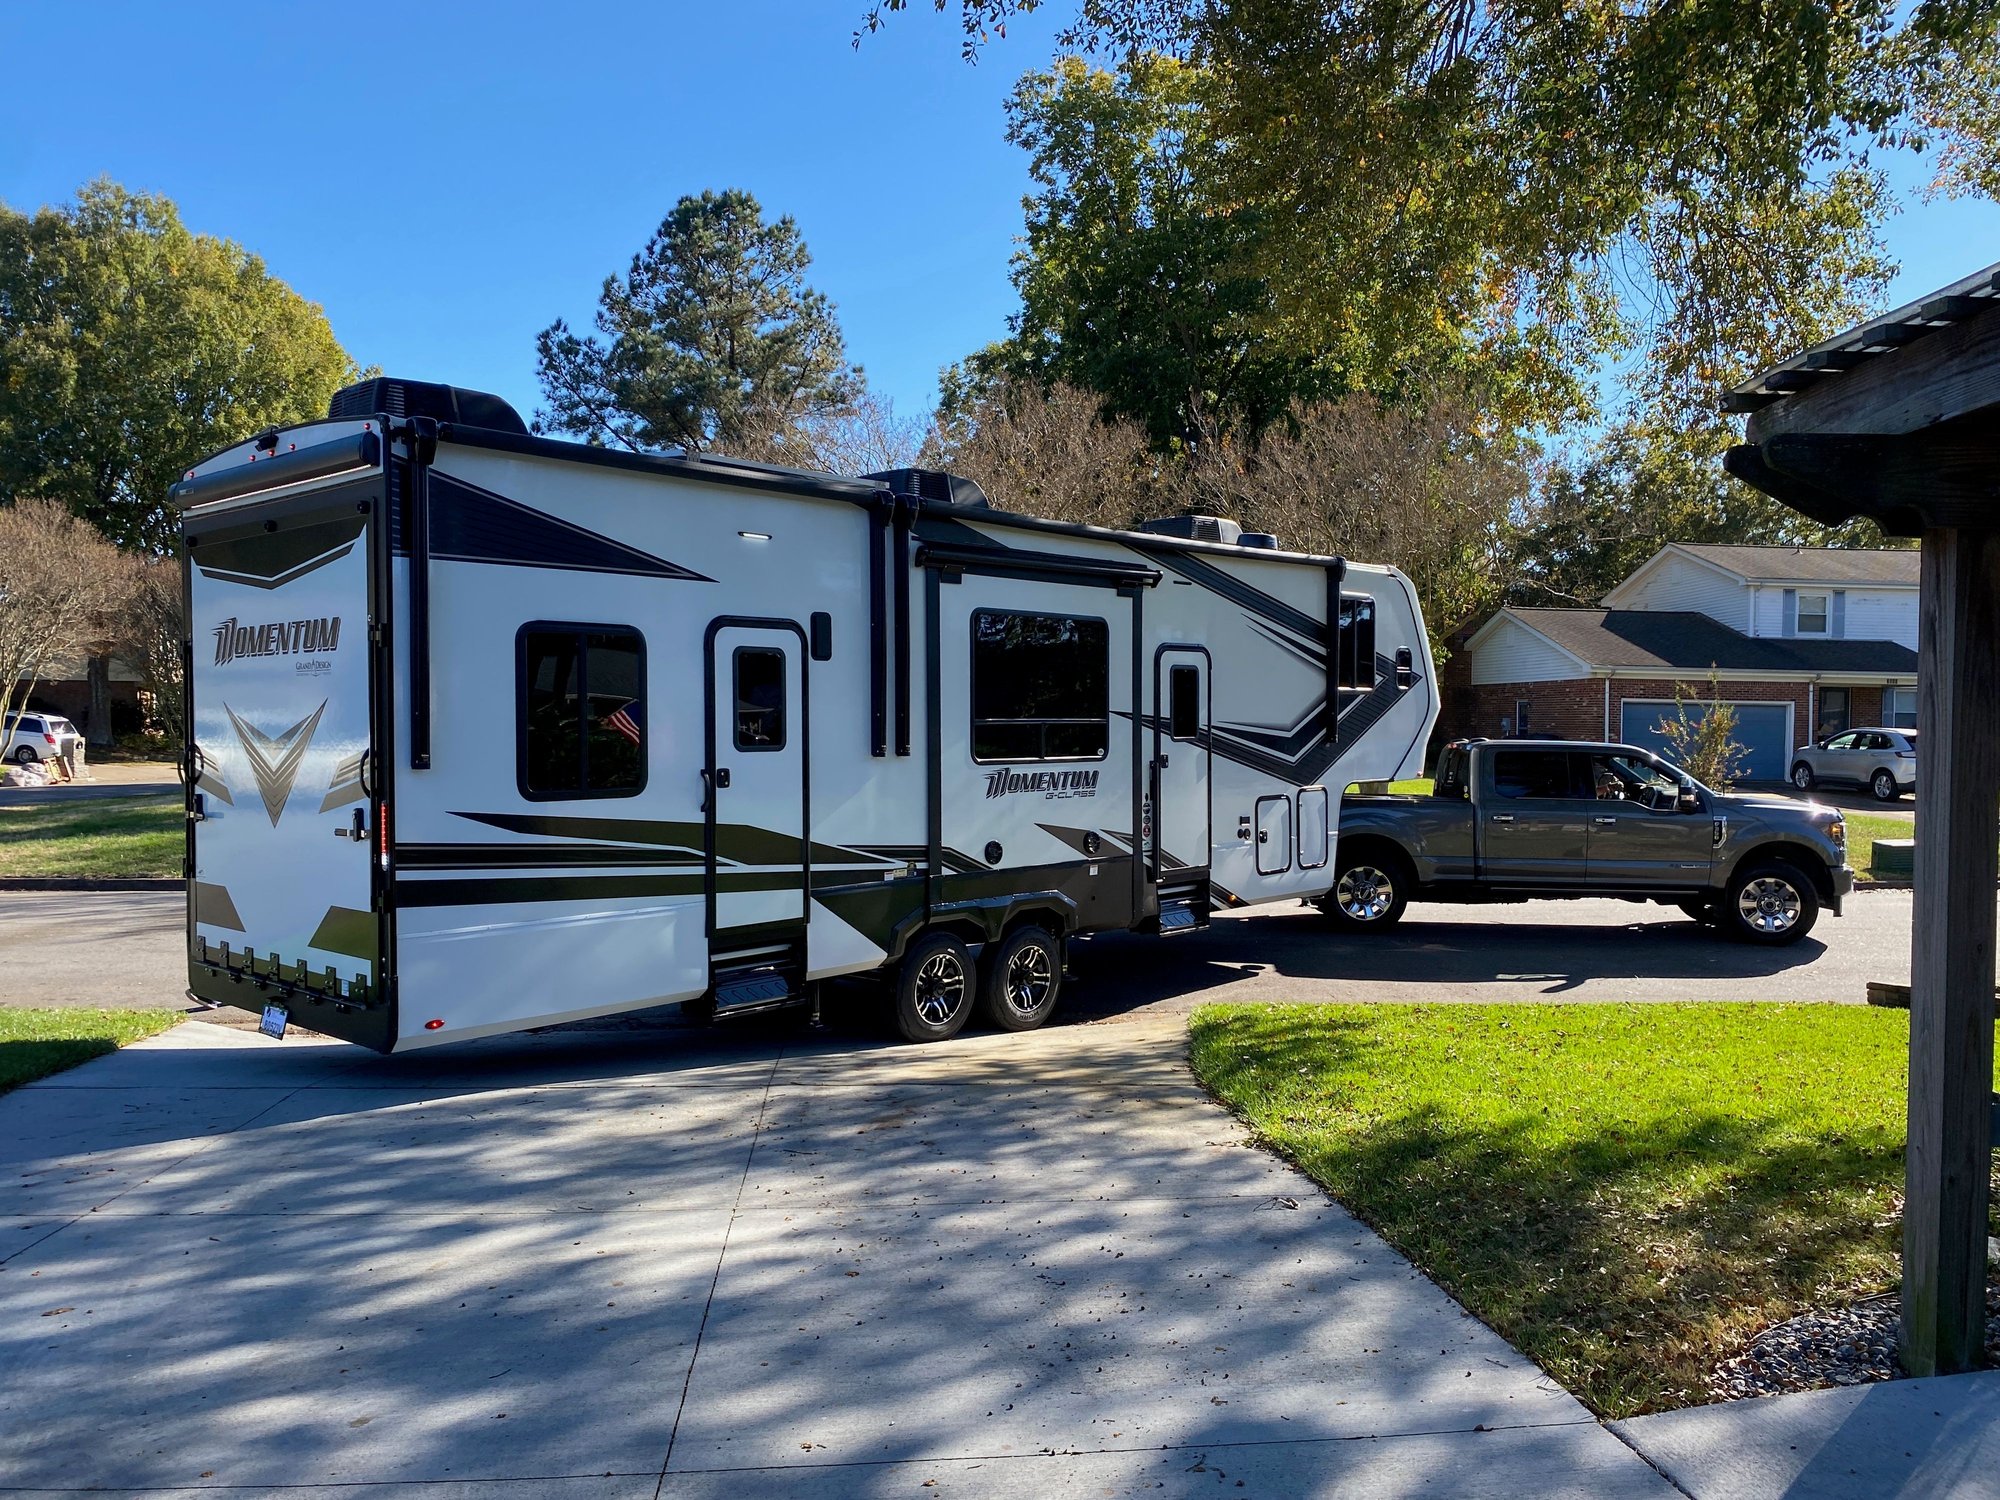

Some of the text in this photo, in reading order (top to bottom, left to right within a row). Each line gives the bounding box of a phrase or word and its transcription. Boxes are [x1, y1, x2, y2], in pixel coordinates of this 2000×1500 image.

[211, 617, 341, 666] MOMENTUM
[982, 767, 1099, 799] MOMENTUM
[1045, 790, 1096, 800] G-CLASS
